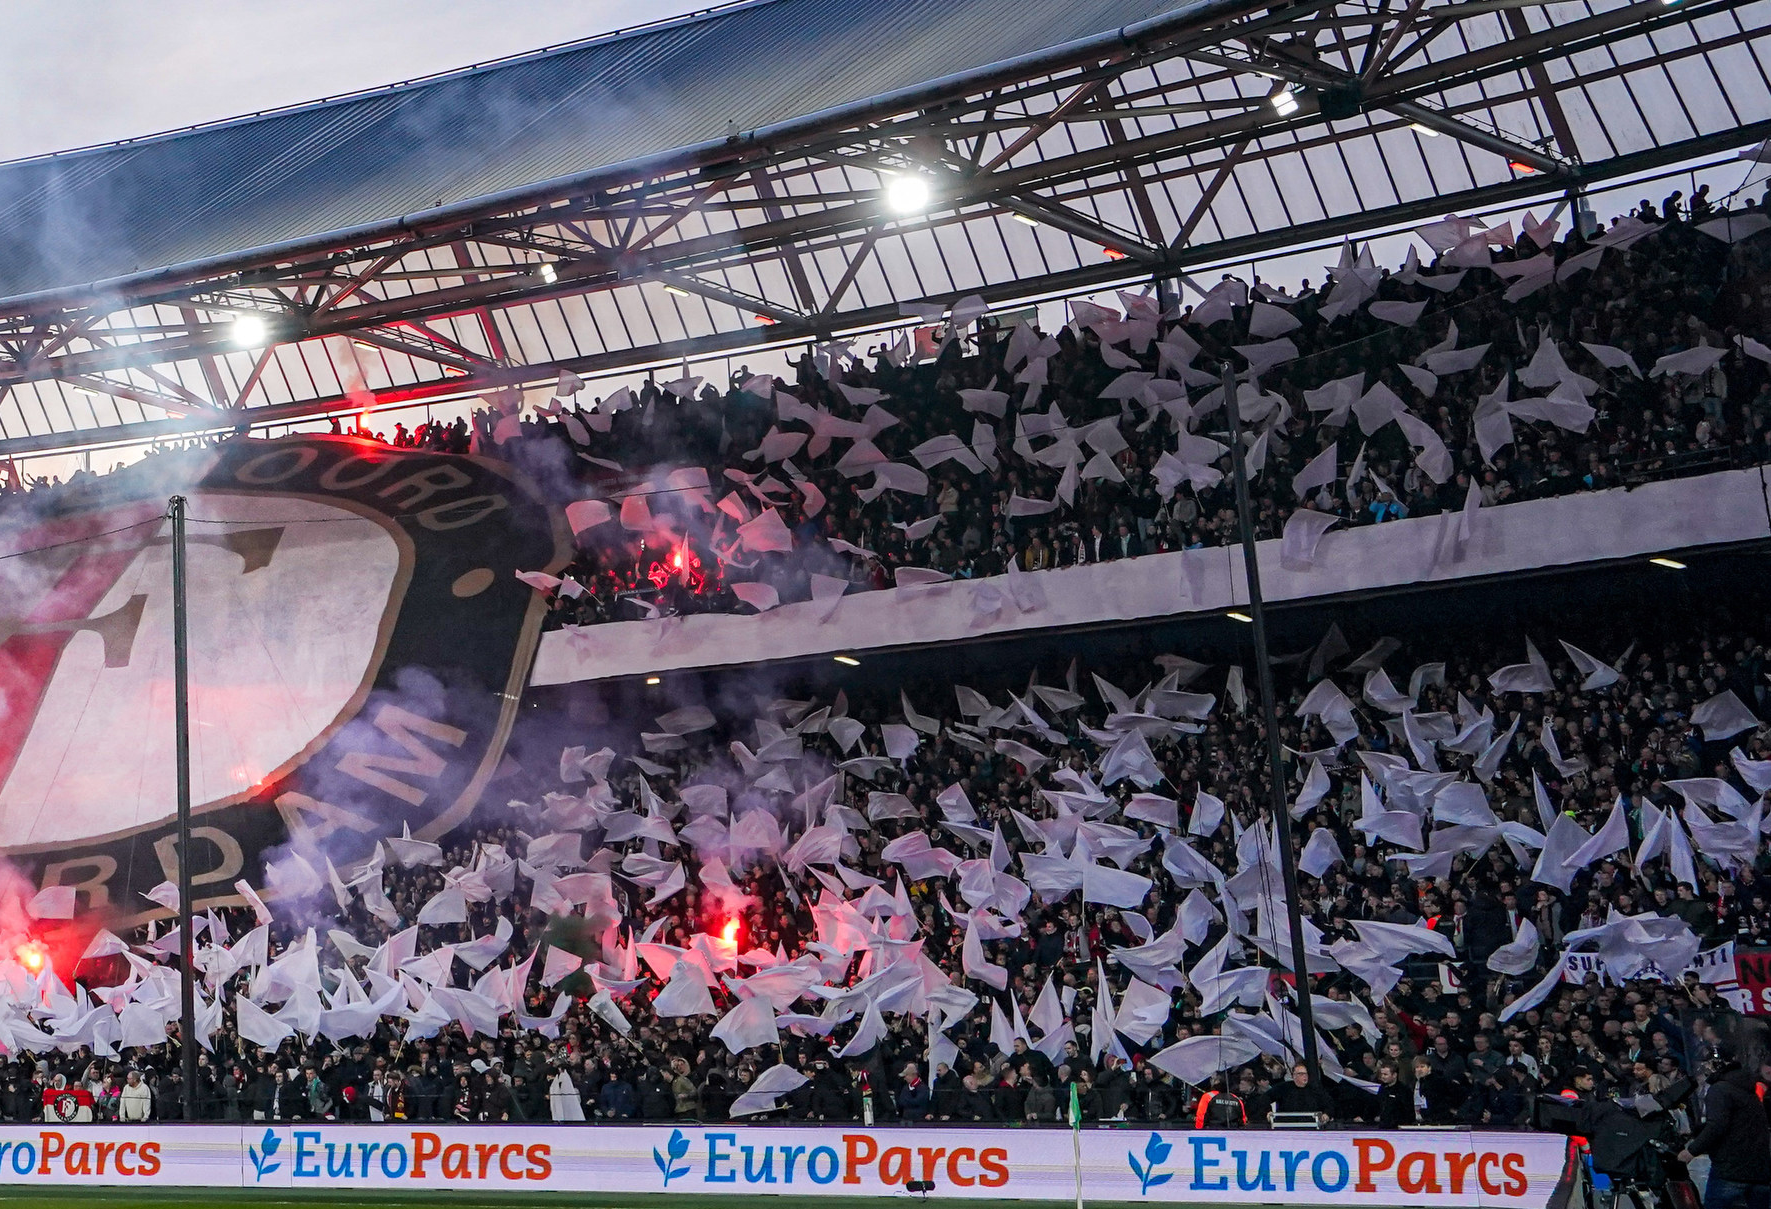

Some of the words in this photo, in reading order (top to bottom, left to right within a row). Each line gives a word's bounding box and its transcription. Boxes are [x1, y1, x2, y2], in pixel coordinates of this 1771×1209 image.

[291, 1131, 552, 1181] EuroParcs
[703, 1133, 1009, 1188] EuroParcs
[1187, 1135, 1528, 1197] EuroParcs
